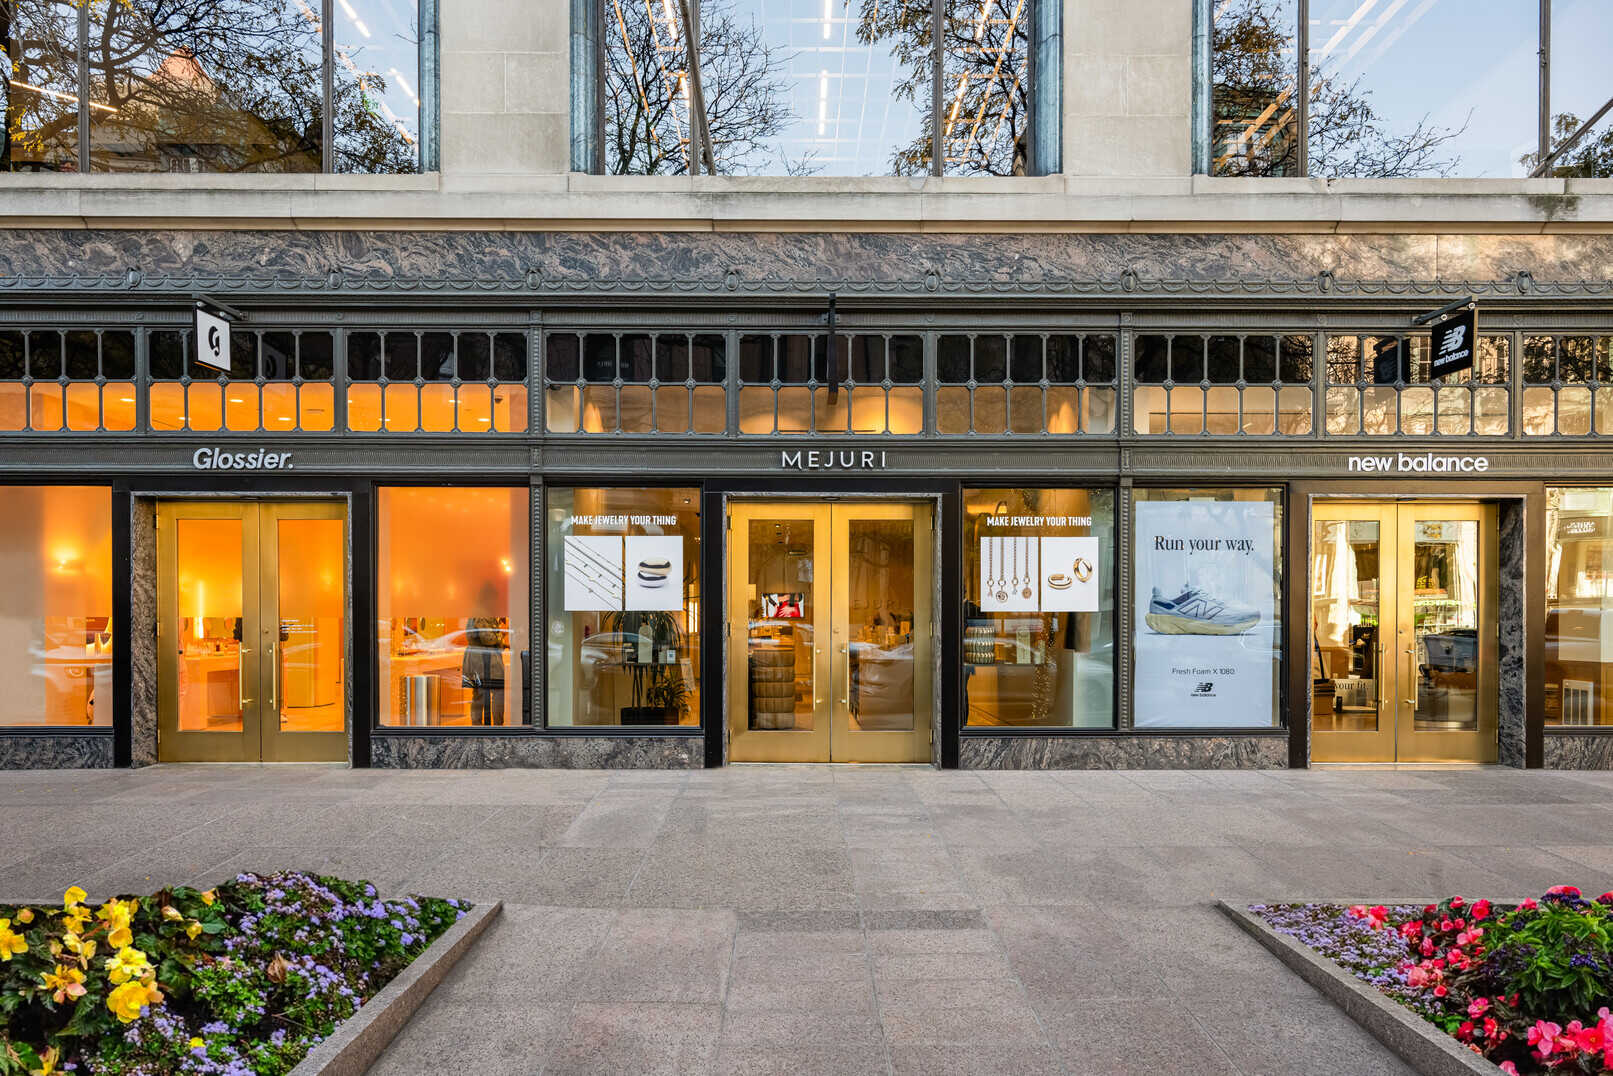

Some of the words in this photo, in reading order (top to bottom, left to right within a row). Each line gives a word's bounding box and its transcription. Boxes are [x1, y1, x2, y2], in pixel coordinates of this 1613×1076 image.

[1433, 357, 1447, 367] new
[1446, 349, 1469, 363] balance
[193, 447, 294, 470] Glossier.
[781, 451, 886, 469] MEJURI
[1348, 456, 1393, 472] new
[1397, 453, 1489, 472] balance
[570, 515, 593, 526] MAKE
[593, 515, 629, 526] JEWELRY
[630, 515, 652, 526] YOUR
[652, 515, 677, 526] THING
[986, 516, 1009, 527] MAKE
[1010, 516, 1045, 527] JEWELRY
[1045, 516, 1067, 527] YOUR
[1067, 516, 1092, 527] THING
[1154, 535, 1185, 551] Run
[1188, 540, 1222, 555] your
[1225, 540, 1255, 555] way.
[1171, 667, 1191, 675] Fresh
[1192, 667, 1212, 675] Foam
